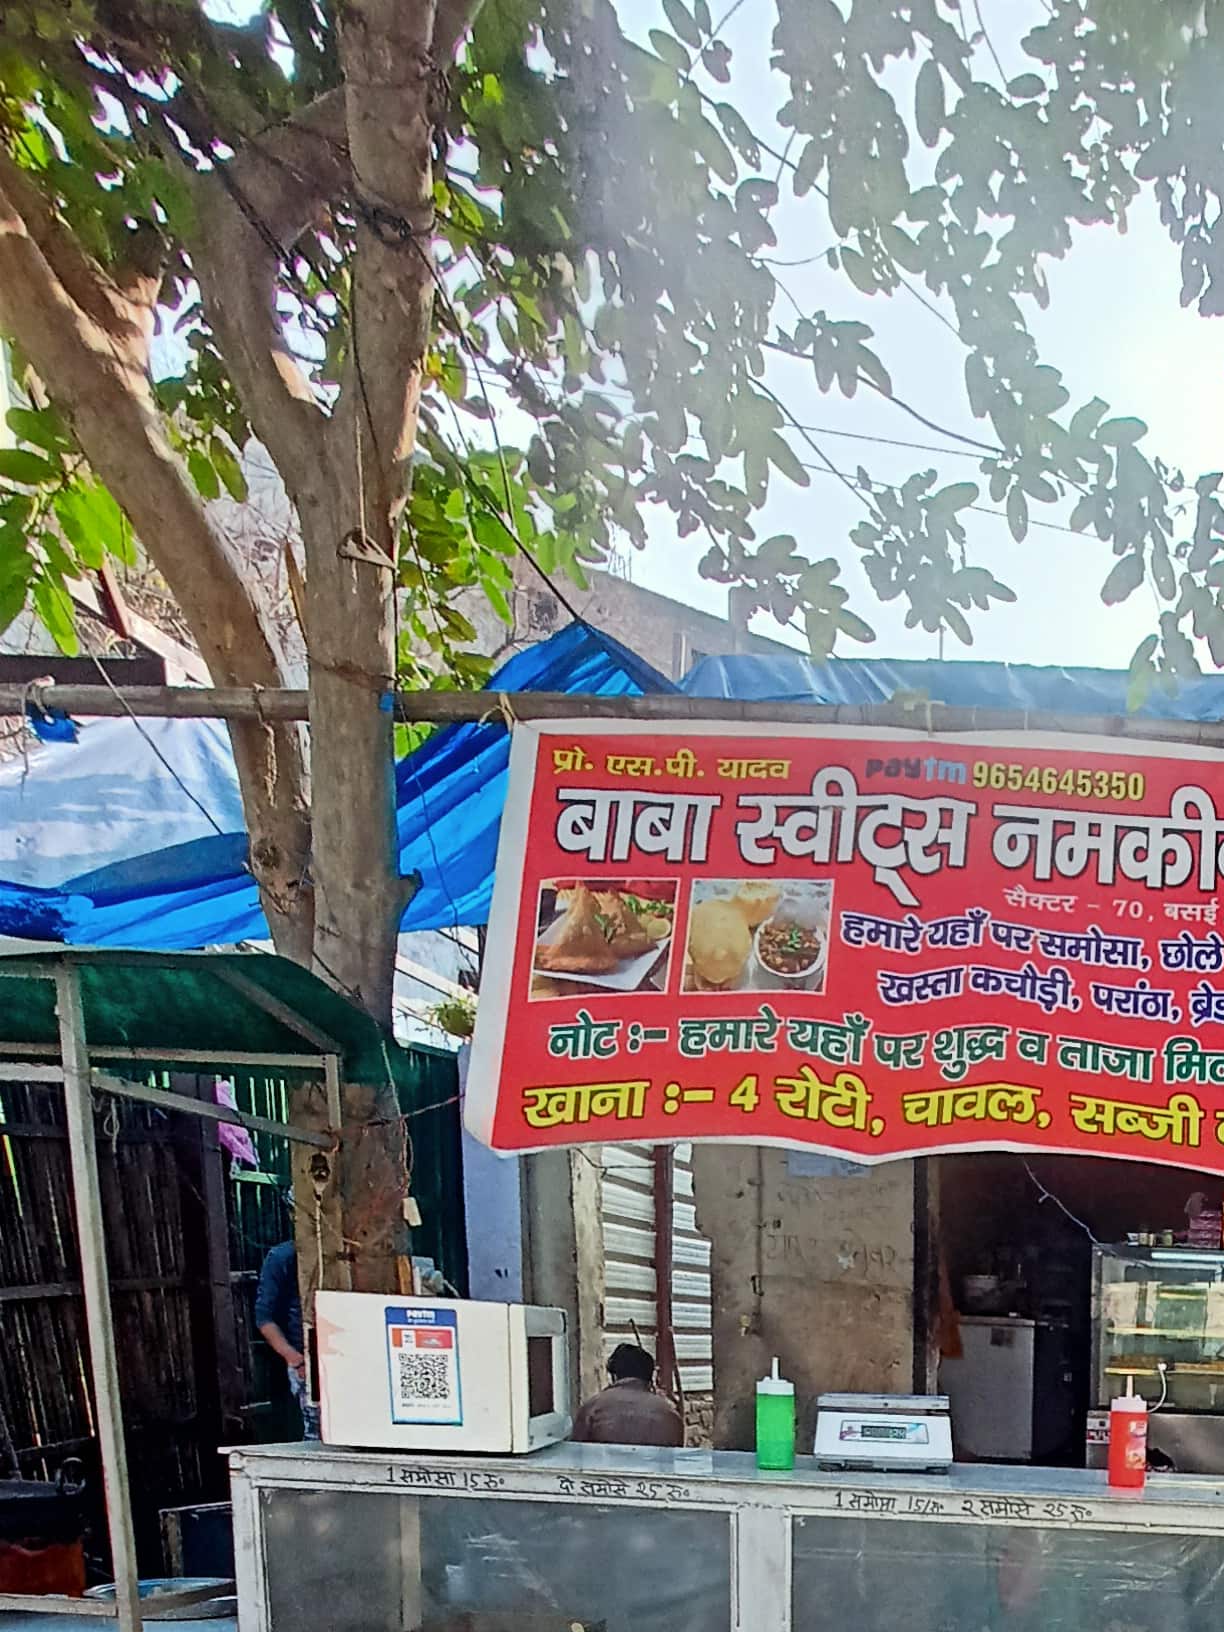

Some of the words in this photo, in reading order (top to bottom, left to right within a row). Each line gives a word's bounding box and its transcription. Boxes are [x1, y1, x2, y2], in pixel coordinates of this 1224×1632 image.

[552, 747, 593, 774] प्रो.
[717, 757, 792, 779] यादव
[973, 760, 1145, 801] 9654645350
[555, 786, 722, 864] बाबा
[736, 766, 978, 907] स्वीट्स
[841, 913, 924, 953] हमारे
[927, 909, 988, 948] यहाँ
[990, 920, 1035, 952] पर
[1039, 926, 1151, 971] समोसा,
[1161, 930, 1224, 971] छोले
[878, 965, 965, 1005] खस्ता
[549, 1009, 622, 1060] नोट
[678, 1004, 781, 1059] हमारे
[786, 1012, 870, 1065] यहाँ
[874, 1030, 927, 1070] पर
[933, 1024, 1010, 1080] शुद्ध
[1017, 1028, 1050, 1064] व
[523, 1080, 651, 1128] खाना
[729, 1075, 759, 1112] 4
[775, 1065, 885, 1136] रोटी,
[902, 1081, 1052, 1129] चावल,
[1069, 1094, 1204, 1146] सब्जी
[400, 1467, 456, 1487] समोसा
